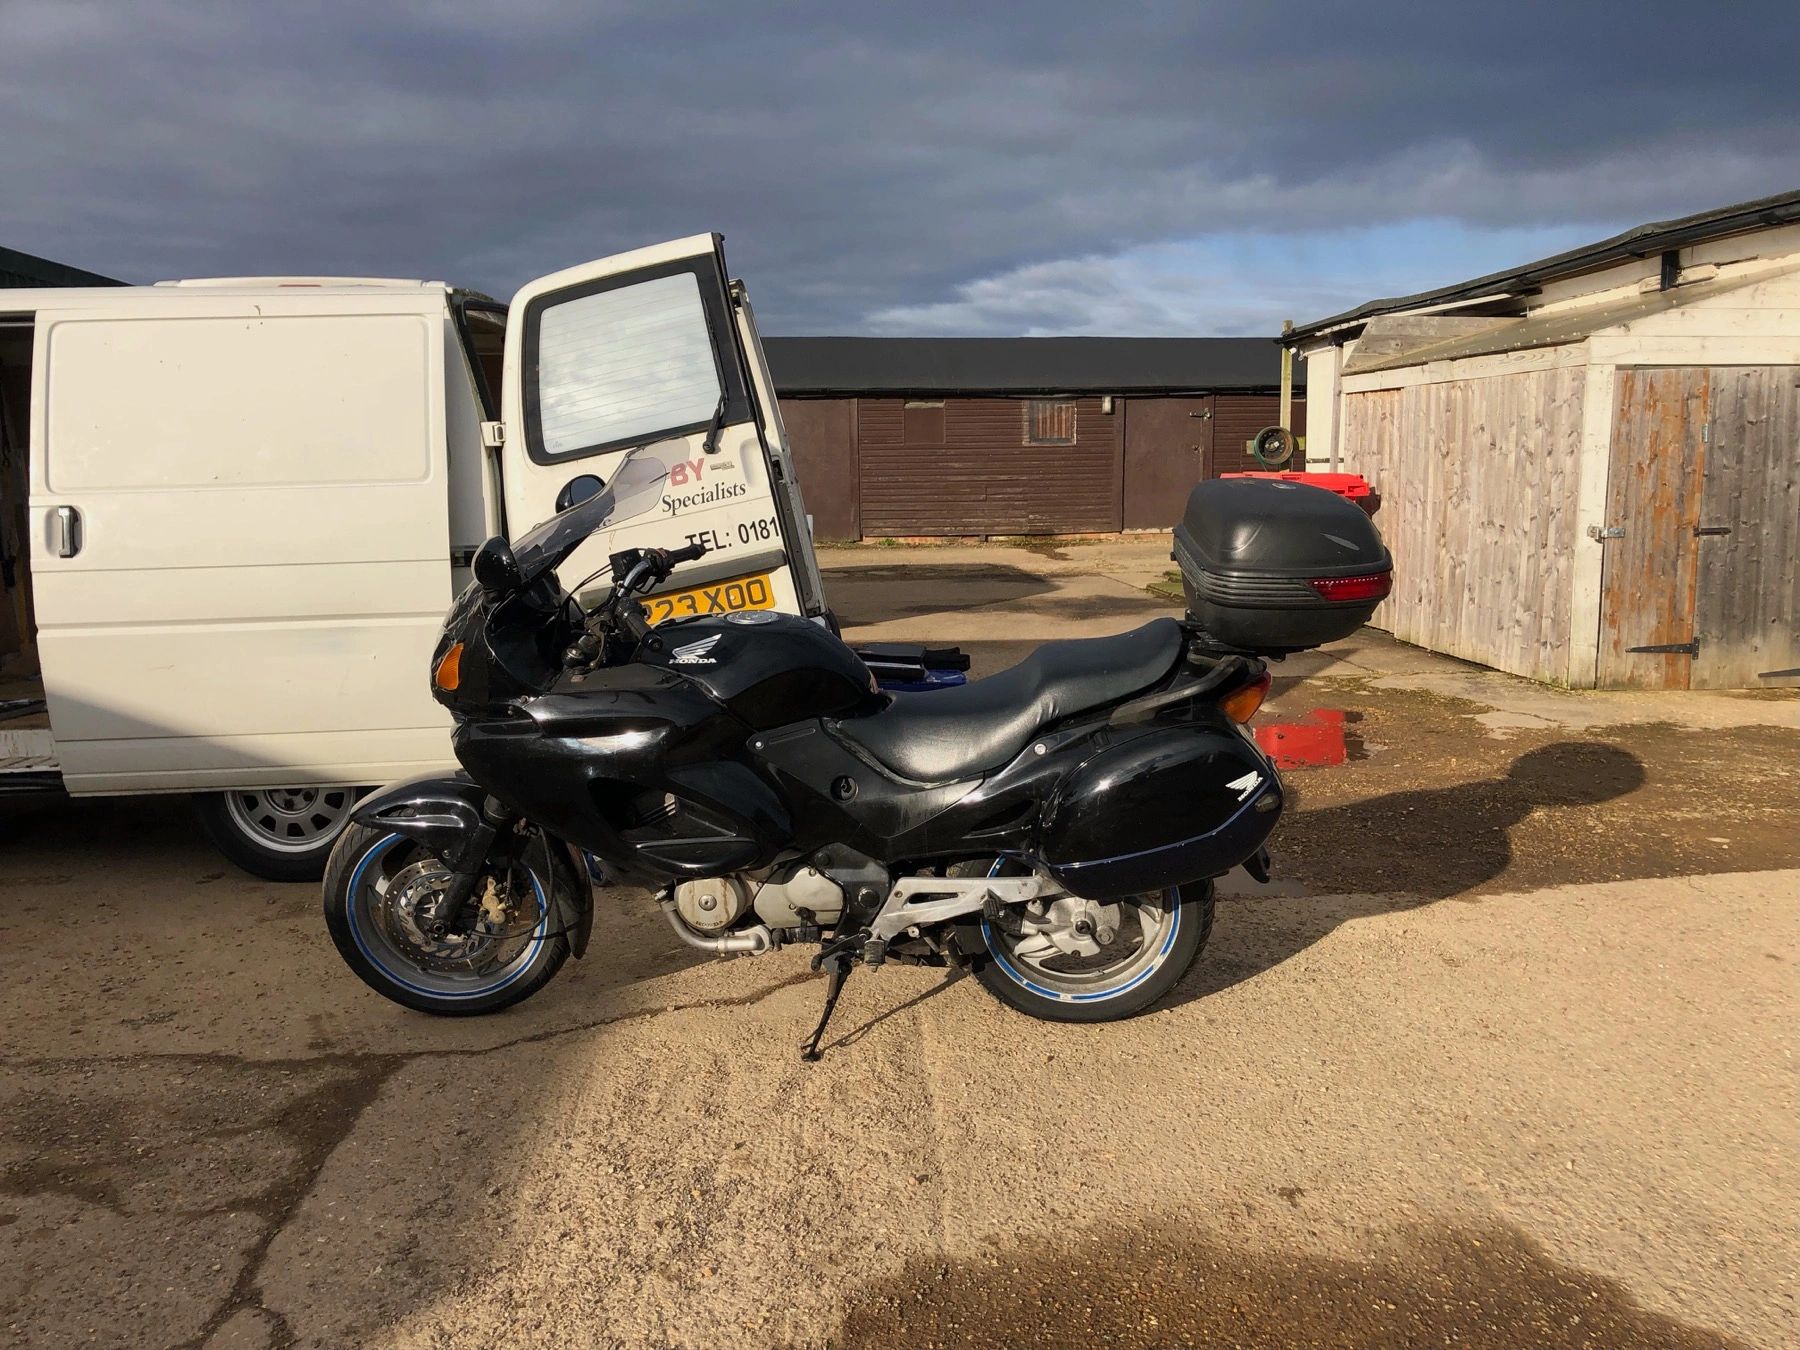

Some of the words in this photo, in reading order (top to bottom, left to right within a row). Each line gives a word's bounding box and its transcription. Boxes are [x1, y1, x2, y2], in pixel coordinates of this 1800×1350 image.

[670, 458, 705, 487] BY
[661, 482, 747, 516] Specialists
[685, 529, 732, 553] TEL:
[738, 516, 779, 544] 0181
[703, 579, 767, 613] XOO
